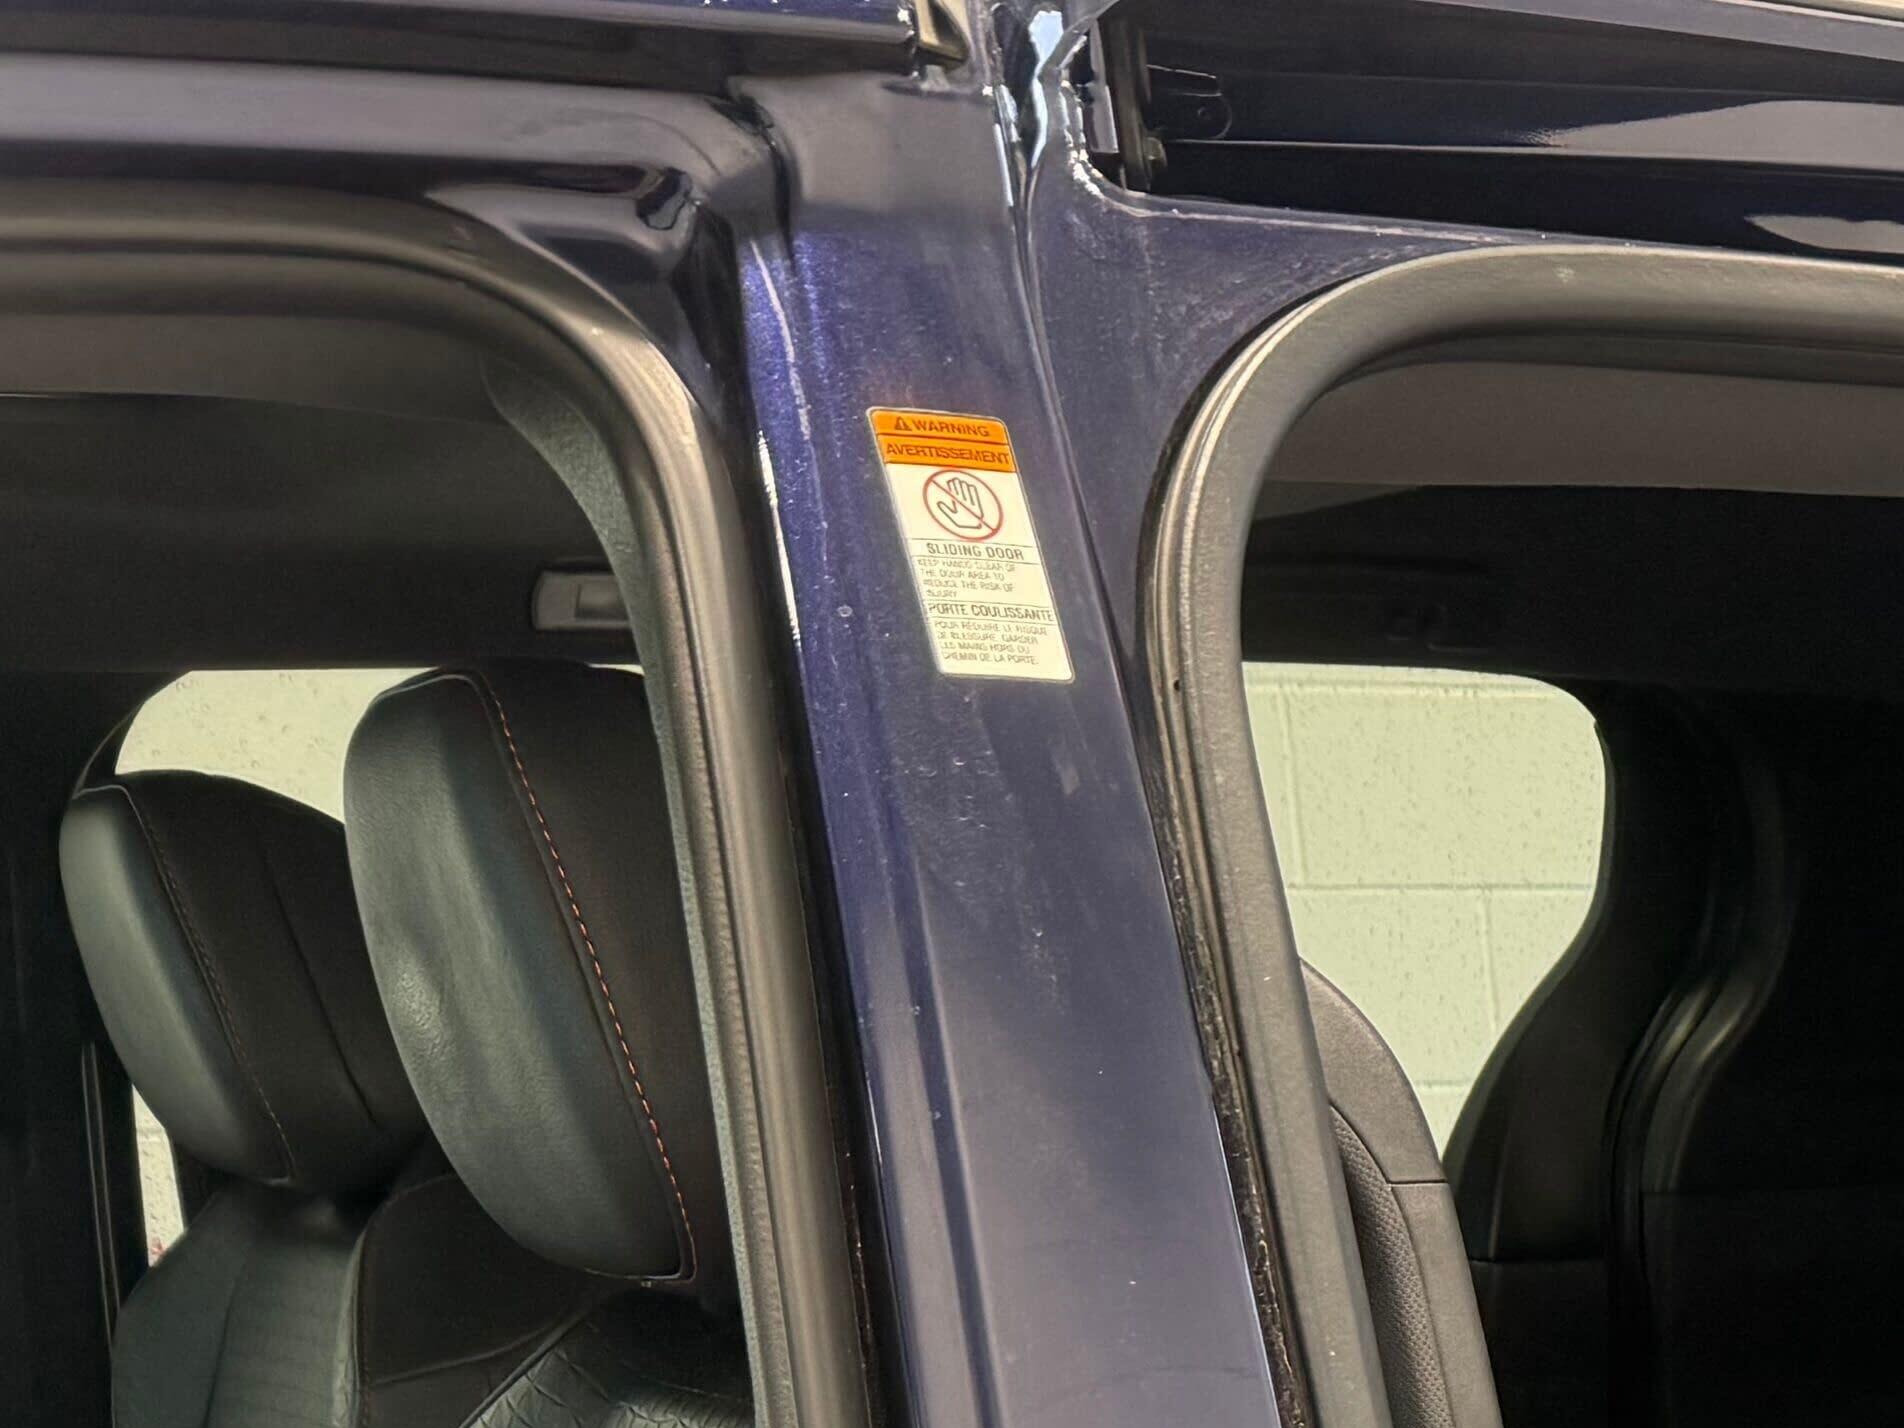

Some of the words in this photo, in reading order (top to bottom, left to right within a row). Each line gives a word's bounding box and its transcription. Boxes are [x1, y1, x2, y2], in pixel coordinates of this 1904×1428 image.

[912, 419, 990, 437] WARNING
[886, 443, 1010, 465] AVERTISSEMENT
[926, 543, 982, 558] SLIDING
[985, 546, 1024, 560] DOOR
[929, 603, 968, 616] PORTE
[971, 605, 1056, 622] COULISSANTE
